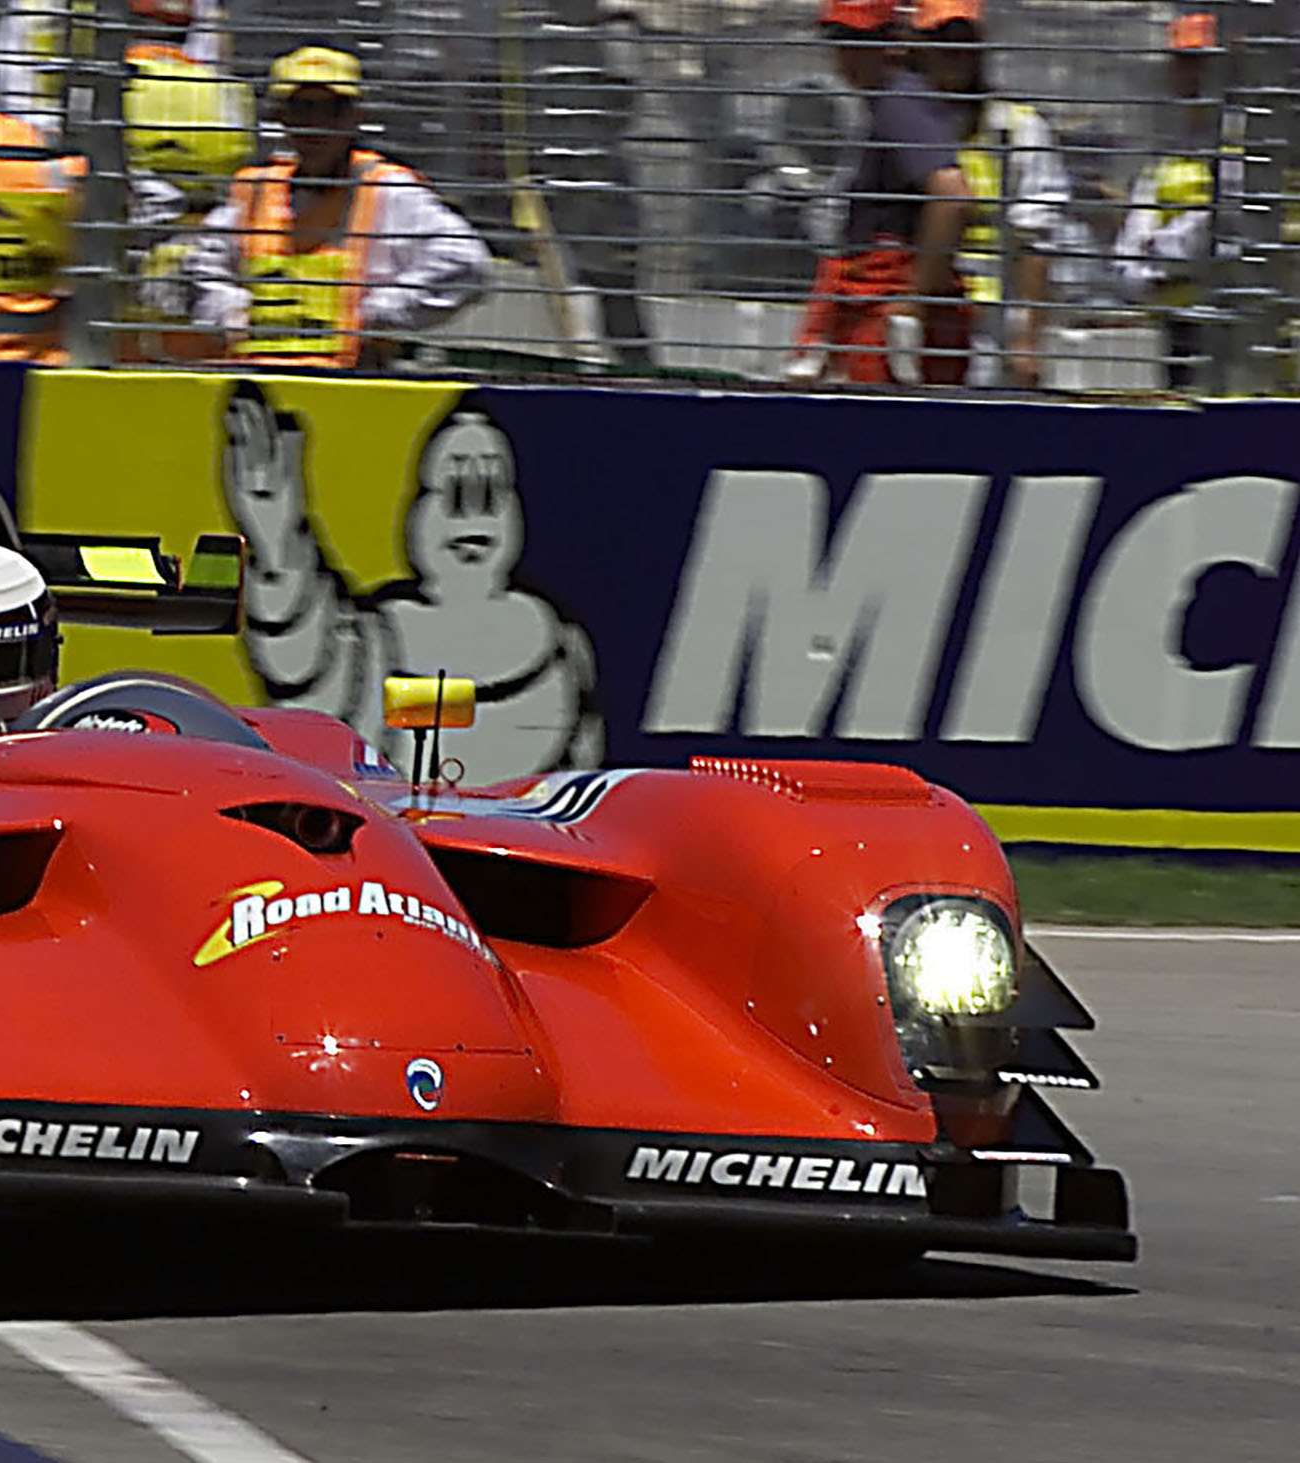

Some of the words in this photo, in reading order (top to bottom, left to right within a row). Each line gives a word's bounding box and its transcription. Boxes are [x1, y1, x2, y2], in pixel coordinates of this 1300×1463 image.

[640, 468, 1300, 751] MIC
[233, 886, 351, 946] Road
[626, 1147, 928, 1197] MICHELIN
